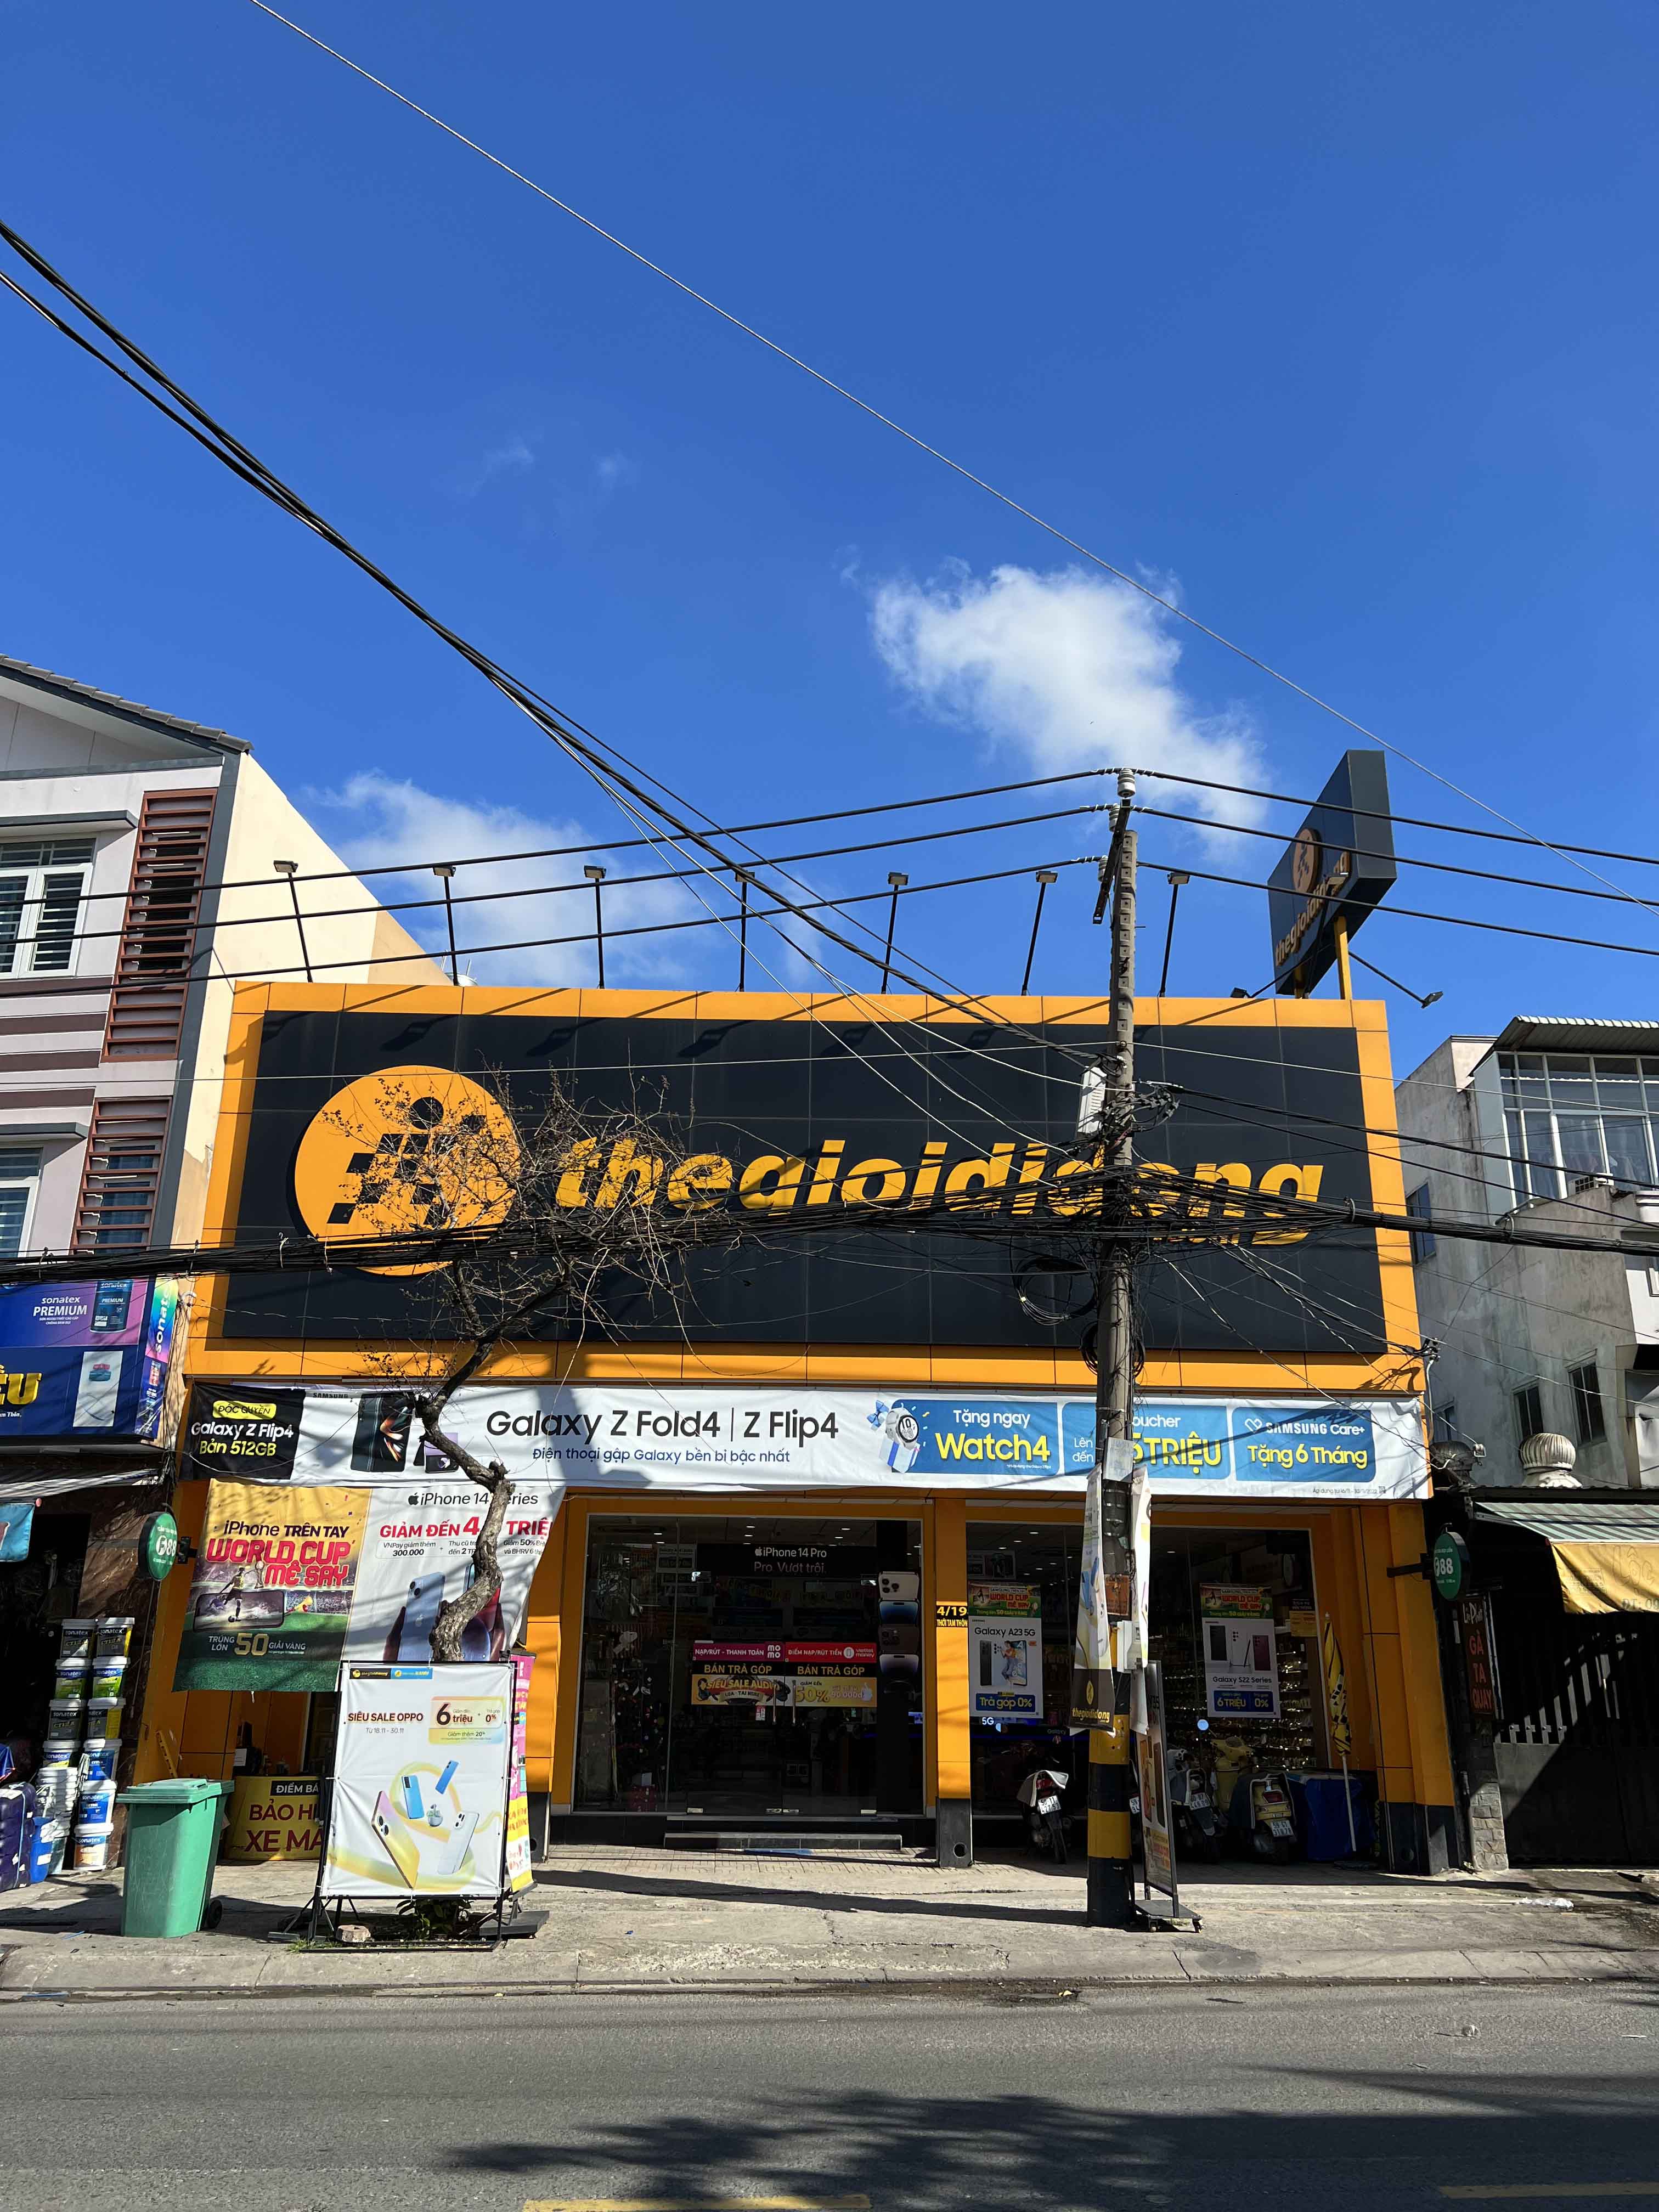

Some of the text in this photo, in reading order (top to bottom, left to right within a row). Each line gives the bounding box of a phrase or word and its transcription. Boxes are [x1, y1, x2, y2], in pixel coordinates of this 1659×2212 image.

[33, 1305, 87, 1316] PREMIUM
[219, 1404, 270, 1415] ĐỘC QUYỀN
[953, 1409, 1031, 1429] Tặng ngay
[1131, 1416, 1181, 1428] oucher
[191, 1422, 294, 1441] Galaxy Z Flip4
[486, 1409, 838, 1447] Galaxy Z Fold4 Z Flip4
[1266, 1422, 1365, 1436] SAMSUNG Care+
[200, 1438, 276, 1456] Bản 512GB
[935, 1432, 1051, 1462] Watch4
[1074, 1437, 1093, 1448] Lên
[533, 1447, 561, 1460] Điện
[566, 1447, 600, 1460] thoại
[603, 1448, 630, 1463] gập
[634, 1449, 681, 1465] Galaxy
[686, 1447, 711, 1462] bền
[730, 1448, 755, 1463] bậc
[759, 1447, 790, 1462] nhất
[1073, 1451, 1094, 1463] đến
[1247, 1444, 1368, 1470] Tặng 6 Tháng
[421, 1492, 539, 1505] iPhone 14 eries
[224, 1521, 349, 1538] iPhone TRÊN TAY
[380, 1521, 422, 1538] GIẢM
[426, 1519, 461, 1537] ĐẾN
[506, 1517, 552, 1540] TRIỆ
[206, 1538, 351, 1565] WORLD CUP
[763, 1547, 827, 1558] iPhone 14 Pro
[776, 1561, 803, 1572] Vượt
[304, 1565, 348, 1586] SAY
[936, 1606, 967, 1616] 4/19
[975, 1627, 1006, 1637] Galaxy
[208, 1635, 235, 1644] TRÚNG
[234, 1633, 270, 1656] 50
[269, 1641, 306, 1650] GIẢI VÀNG
[704, 1664, 772, 1674] BÁN TRẢ GÓP
[797, 1666, 865, 1675] BÁN TRẢ GÓP
[729, 1679, 751, 1689] SALE
[795, 1686, 830, 1702] 50%
[979, 1697, 1032, 1709] Trả góp 0%
[1255, 1698, 1268, 1707] 0%
[348, 1711, 424, 1722] SIÊU SALE OPPO
[437, 1703, 451, 1725] 6
[453, 1715, 473, 1724] triệu
[276, 1782, 319, 1793] ĐIỂM BÁ
[249, 1799, 294, 1820] BẢO
[245, 1826, 324, 1852] XE MÁ
